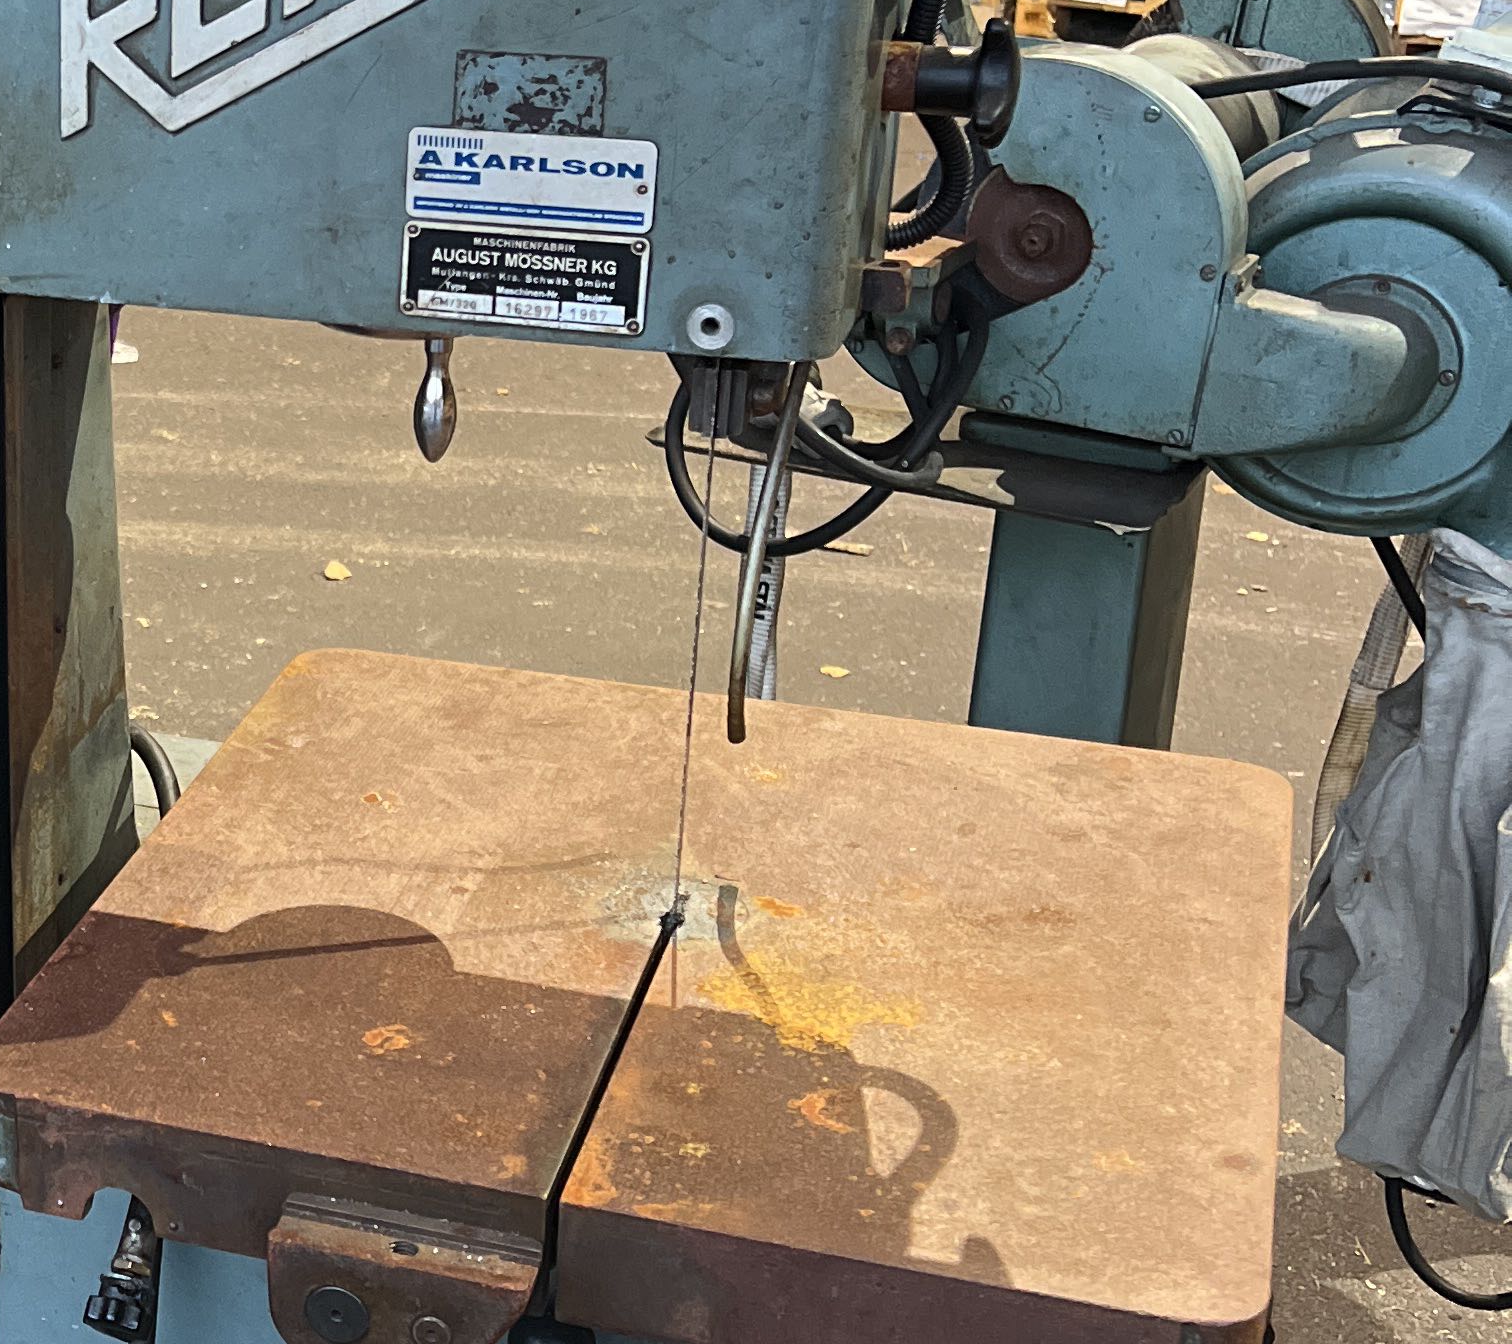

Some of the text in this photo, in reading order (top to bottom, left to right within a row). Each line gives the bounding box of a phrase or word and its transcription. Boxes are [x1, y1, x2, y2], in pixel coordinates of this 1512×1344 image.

[419, 150, 644, 179] A KARLSON
[473, 237, 576, 253] MASCHINENFABRIK
[432, 248, 617, 276] AUGUST MÖSSNER KG
[445, 281, 467, 292] Type
[576, 292, 614, 304] Baujahr
[575, 277, 616, 290] Gmünd
